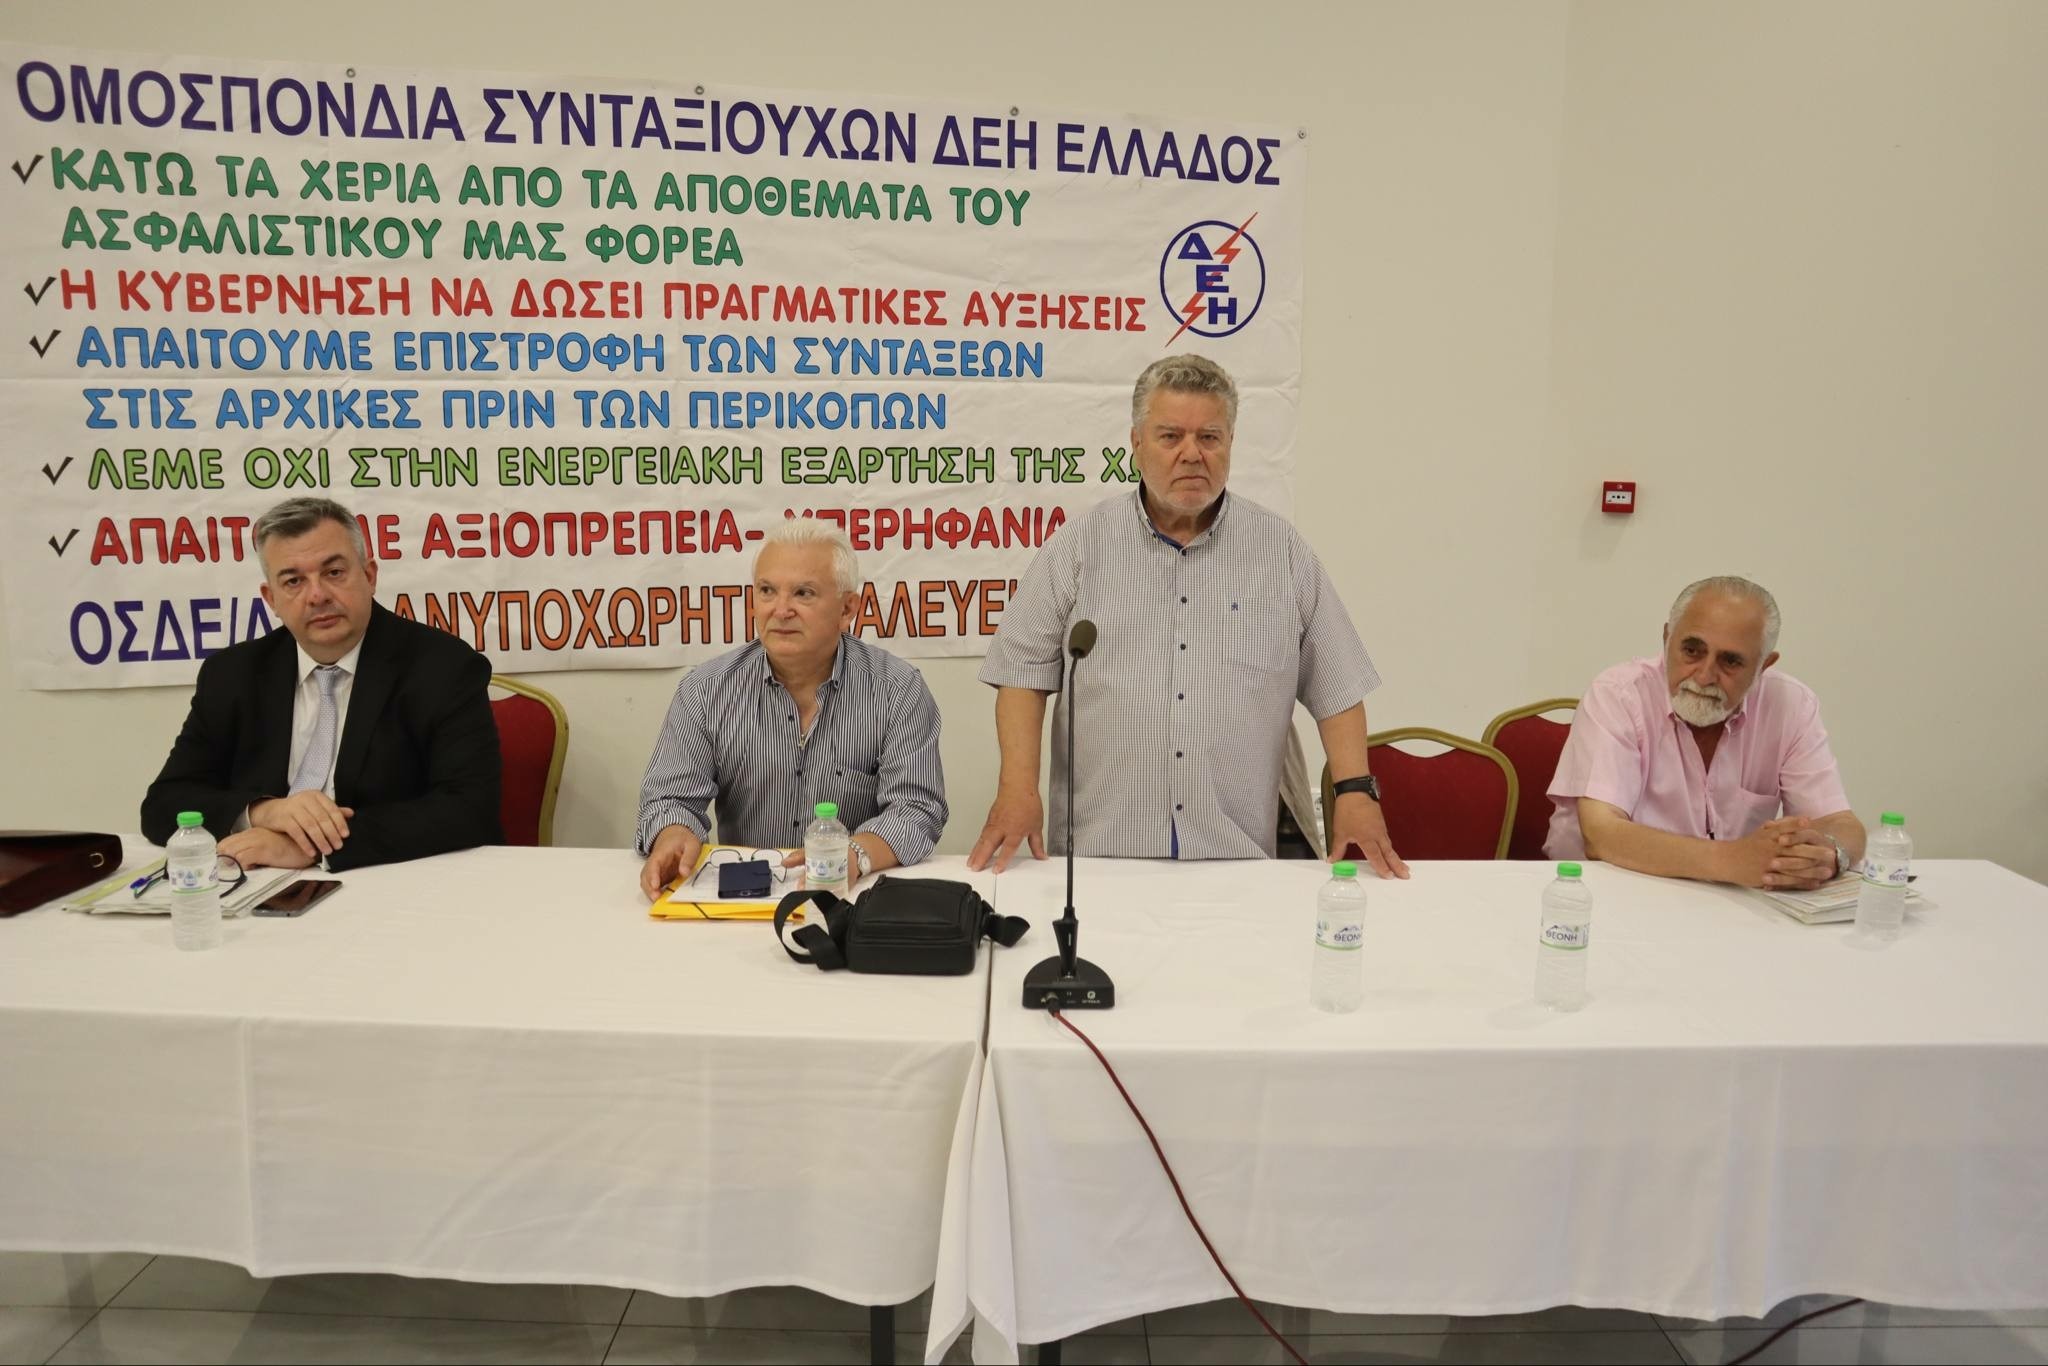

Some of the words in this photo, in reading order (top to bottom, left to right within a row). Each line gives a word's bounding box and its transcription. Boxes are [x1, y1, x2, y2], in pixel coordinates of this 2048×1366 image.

[17, 61, 465, 141] ΟΜΟΣΠΟΝΔΙΑ
[483, 89, 916, 163] ΣΥΝΤΑΞΙΟΥΧΩΝ
[933, 115, 1037, 170] ΔΕΗ
[1057, 123, 1280, 185] ΕΛΛΑΔΟΣ
[51, 147, 196, 196] ΚΑΤΩ
[216, 156, 279, 198] ΤΑ
[300, 159, 440, 203] ΧΕΡΙΑ
[459, 165, 562, 208] ΑΠΟ
[582, 170, 637, 210] ΤΑ
[654, 172, 932, 222] ΑΠΟΘΕΜΑΤΑ
[949, 187, 1030, 226] ΤΟΥ
[62, 207, 442, 259] ΑΣΦΑΛΙΣΤΙΚΟΥ
[464, 220, 566, 261] ΜΑΣ
[586, 224, 743, 266] ΦΟΡΕΑ
[61, 269, 96, 310] Η
[118, 270, 410, 316] ΚΥΒΕΡΝΗΣΗ
[432, 278, 493, 316] ΝΑ
[511, 279, 642, 319] ΔΩΣΕΙ
[664, 283, 947, 325] ΠΡΑΓΜΑΤΙΚΕΣ
[963, 291, 1146, 331] ΑΥΞΗΣΕΙΣ
[77, 326, 372, 370] ΑΠΑΙΤΟΥΜΕ
[394, 332, 664, 372] ΕΠΙΣΤΡΟΦΗ
[682, 335, 775, 373] ΤΩΝ
[799, 337, 1043, 378] ΣΥΝΤΑΞΕΩΝ
[83, 388, 196, 429] ΣΤΙΣ
[216, 388, 421, 429] ΑΡΧΙΚΕΣ
[443, 390, 555, 429] ΠΡΙΝ
[576, 391, 669, 428] ΤΩΝ
[689, 391, 946, 430] ΠΕΡΙΚΟΠΩΝ
[88, 448, 224, 490] ΛΕΜΕ
[244, 447, 330, 489] ΟΧΙ
[349, 447, 478, 488] ΣΤΗΝ
[498, 446, 762, 486] ΕΝΕΡΓΕΙΑΚΗ
[782, 446, 994, 484] ΕΞΑΡΤΗΣΗ
[1011, 447, 1085, 483] ΤΗΣ
[90, 512, 402, 566] ΑΠΑΙΤΕ
